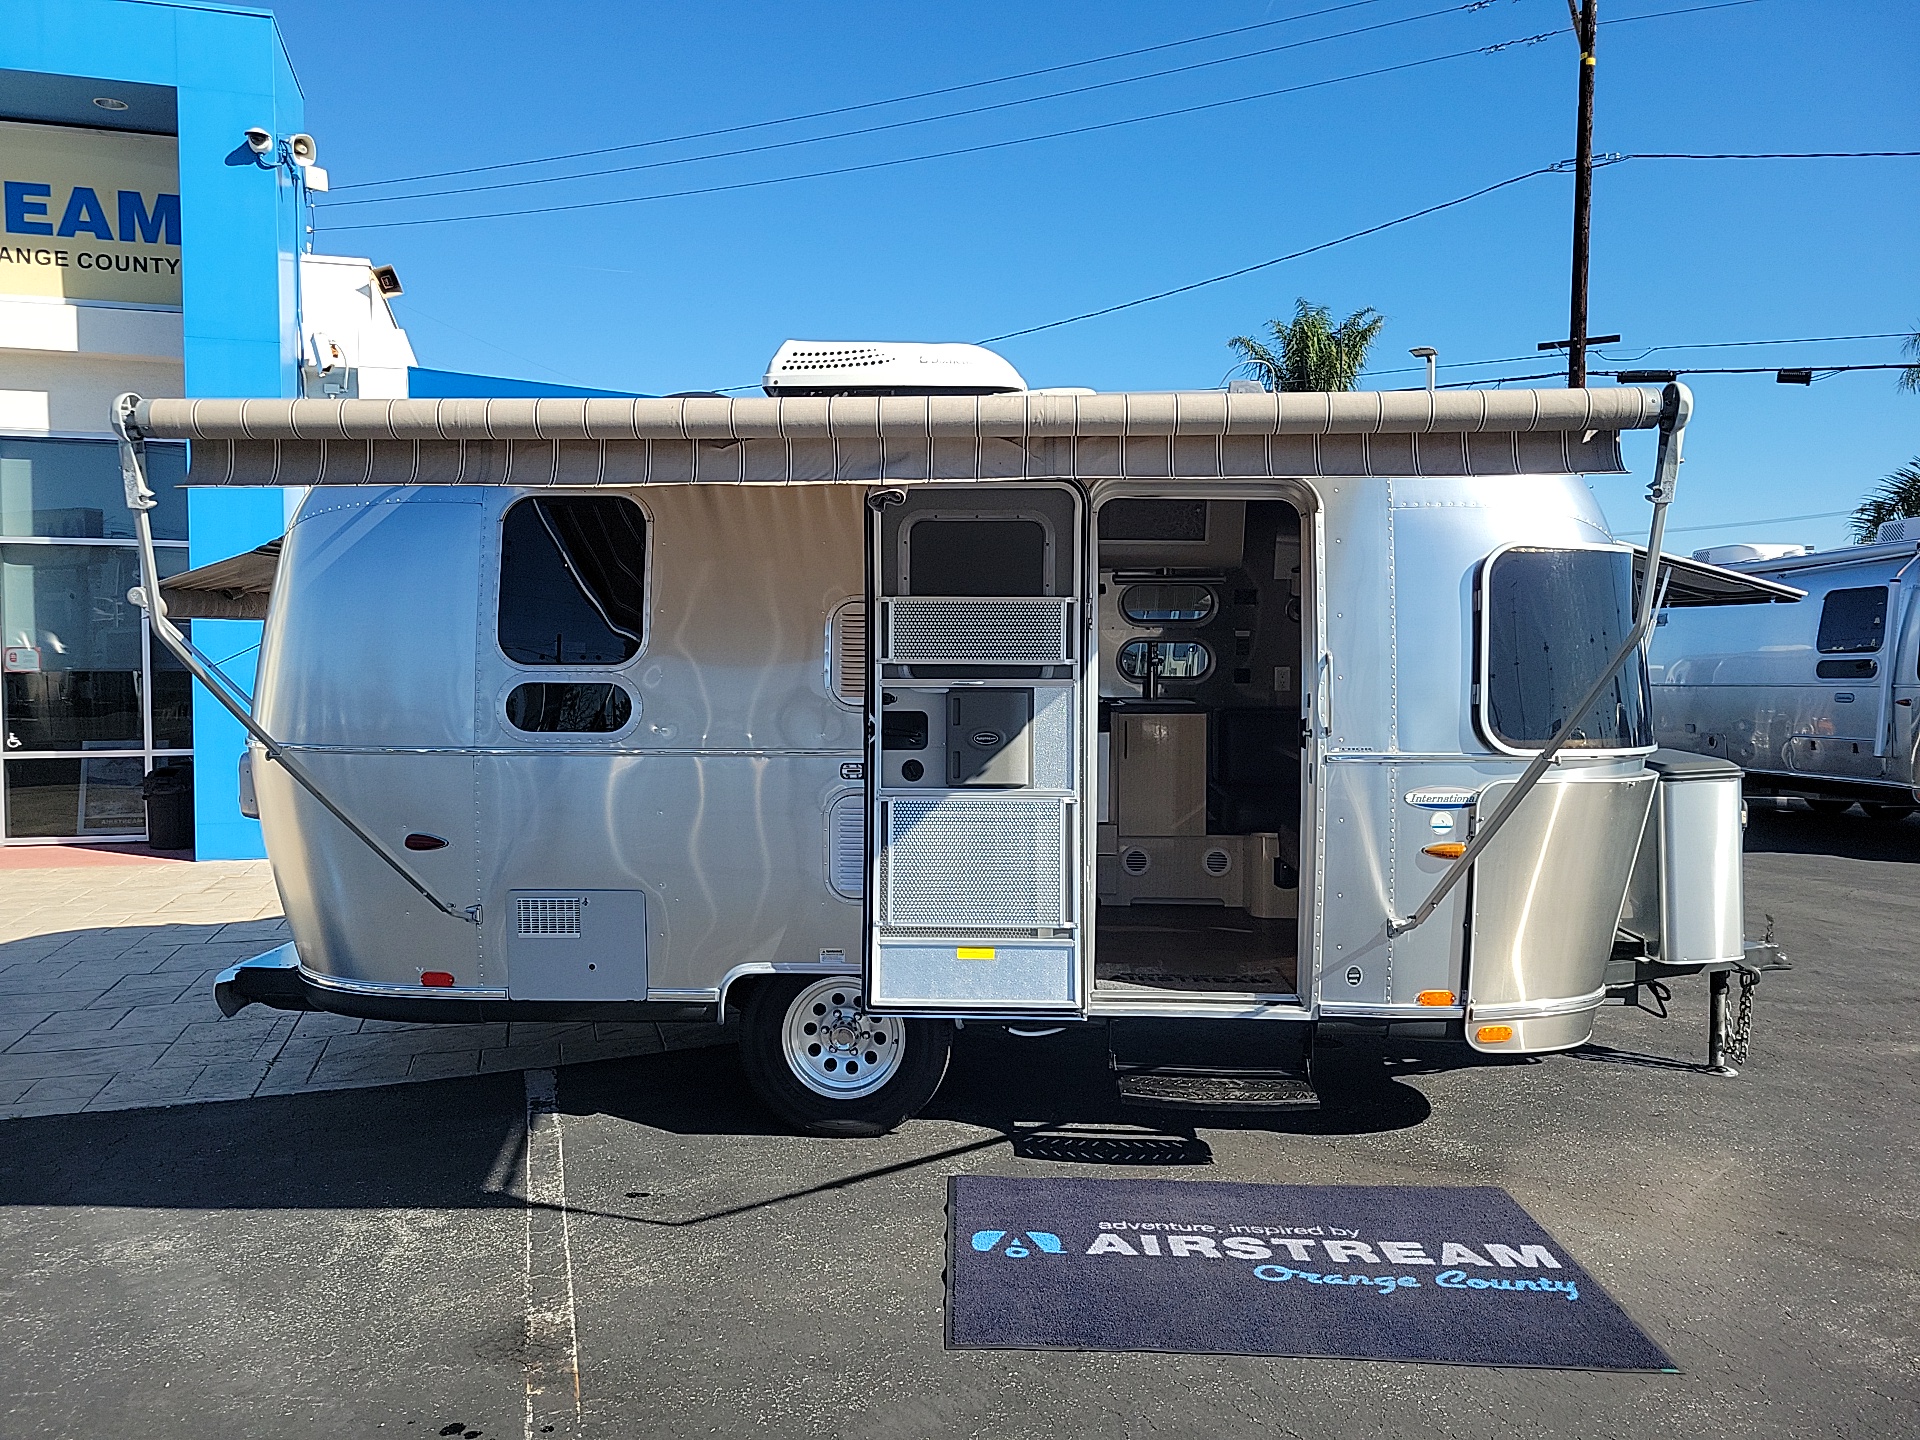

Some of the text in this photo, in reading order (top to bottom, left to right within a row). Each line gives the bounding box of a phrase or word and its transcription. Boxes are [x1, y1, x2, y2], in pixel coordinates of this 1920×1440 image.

[4, 181, 181, 246] EAM
[77, 252, 180, 274] COUNTY
[1098, 1220, 1360, 1239] adventure, inspired by
[1085, 1232, 1562, 1269] AIRSTREAM
[1253, 1264, 1579, 1301] Orange County
